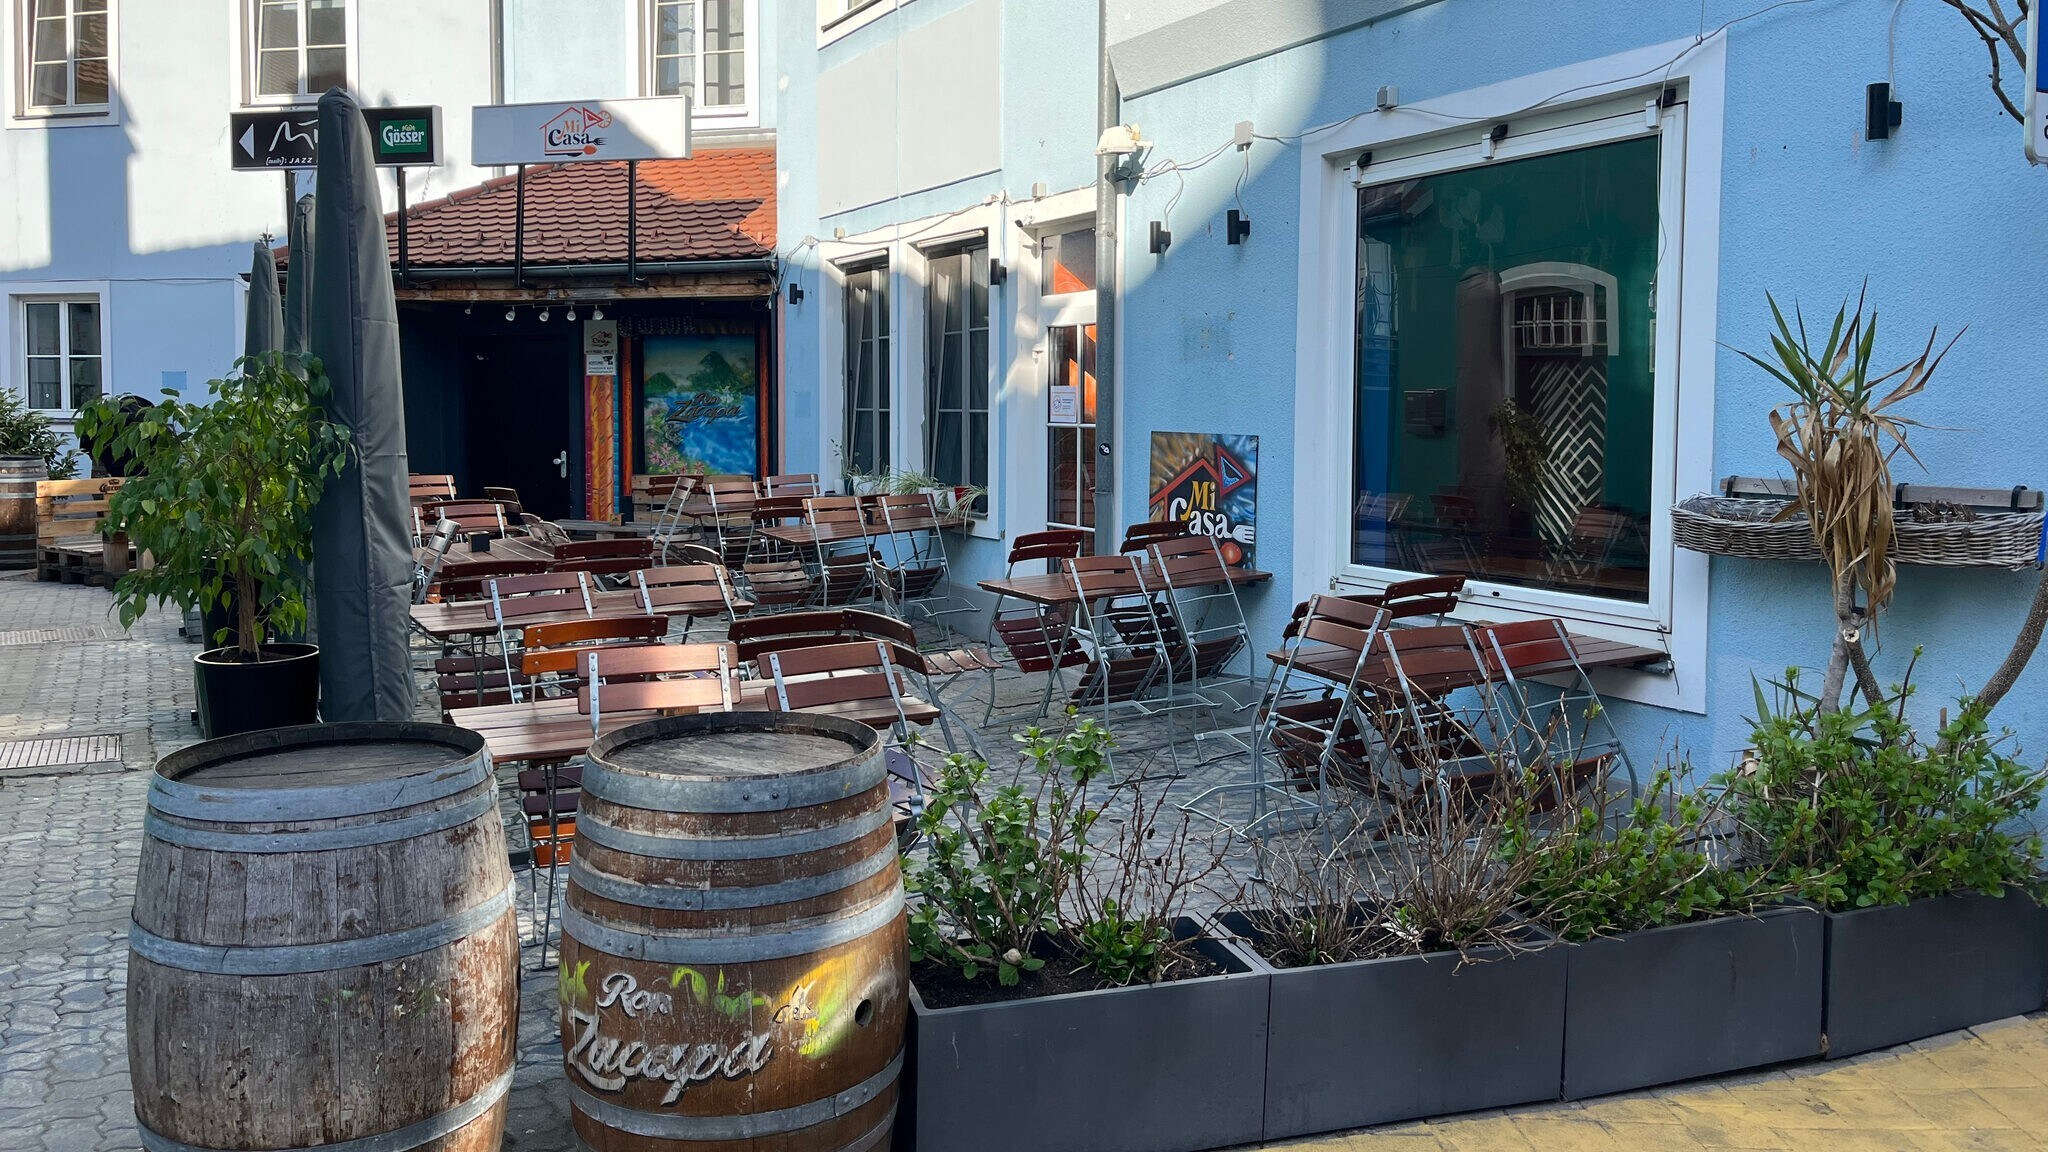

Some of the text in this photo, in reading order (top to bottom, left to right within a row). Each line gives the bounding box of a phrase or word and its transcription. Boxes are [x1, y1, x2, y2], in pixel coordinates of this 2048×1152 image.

[382, 124, 425, 147] Gösser
[548, 128, 592, 147] Casa
[560, 119, 580, 136] Mi
[1182, 480, 1216, 519] Mi
[1169, 497, 1231, 539] Casa
[596, 971, 673, 1018] Ron
